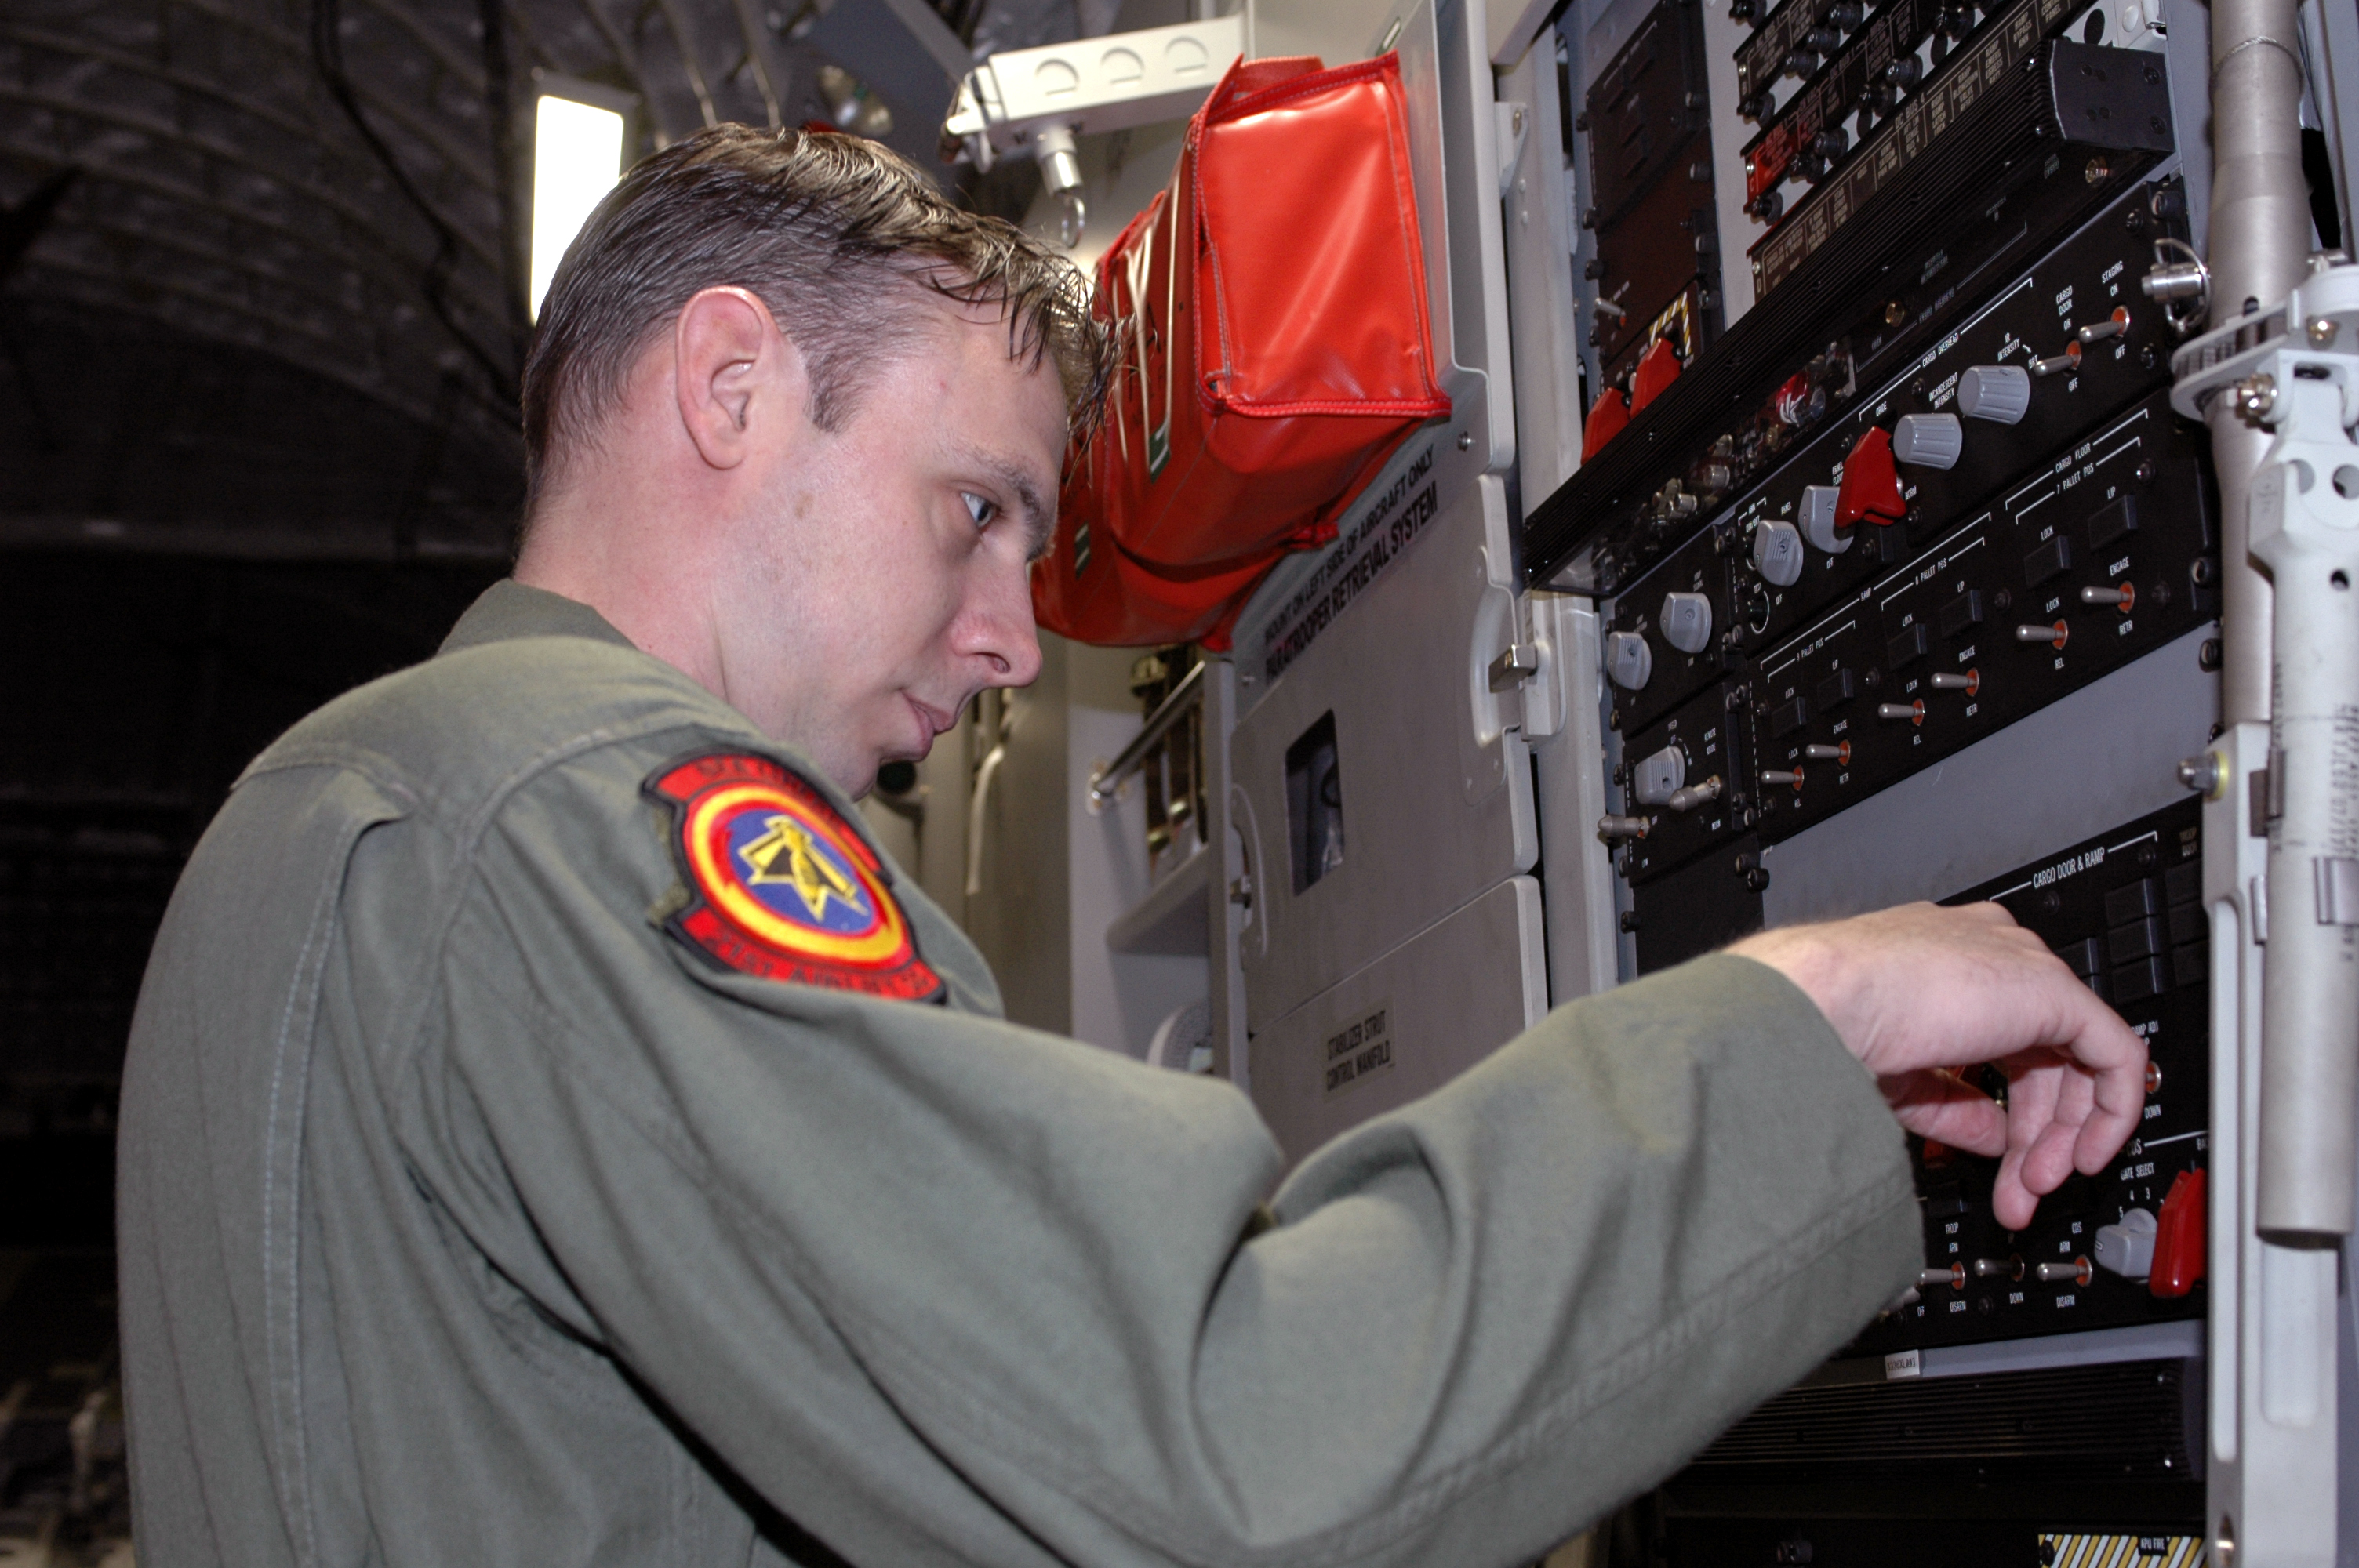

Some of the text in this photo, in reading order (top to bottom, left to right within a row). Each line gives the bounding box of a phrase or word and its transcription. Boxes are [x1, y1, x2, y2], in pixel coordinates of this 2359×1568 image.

[2102, 260, 2124, 285] STAGING
[2055, 285, 2074, 305] CARGO
[2110, 282, 2119, 297] ON
[2058, 298, 2073, 317] DOOR
[2063, 317, 2072, 332] ON
[1997, 337, 2020, 362] INTENSITY
[2115, 343, 2126, 361] OFF
[1928, 372, 1957, 402] INCANDESCENT
[2068, 377, 2078, 394] OFF
[1934, 387, 1954, 410] INTENSITY
[2055, 442, 2091, 474] CARGO FLOOR
[2062, 470, 2081, 491] PALLET
[2082, 463, 2095, 478] POS
[1306, 565, 1327, 602] LEFT
[1347, 530, 1358, 555] OF
[1360, 475, 1406, 542] AIRCRAFT
[1408, 444, 1434, 488] ONLY
[2041, 524, 2054, 542] LOCK
[1332, 534, 1390, 617] RETRIEVAL
[1391, 481, 1438, 555] SYSTEM
[1920, 564, 1936, 582] PALLET
[1937, 557, 1947, 572] POS
[2109, 556, 2130, 577] ENGAGE
[2045, 596, 2060, 614] LOCK
[1902, 612, 1914, 627] LOCK
[1958, 644, 1976, 663] ENGAGE
[2055, 657, 2065, 670] REL
[1785, 686, 1794, 700] LOCK
[1906, 678, 1918, 694] LOCK
[1833, 719, 1848, 735] ENGAGE
[1788, 747, 1799, 760] LOCK
[2033, 846, 2106, 890] CARGO DOOR & RAMP
[1328, 1023, 1362, 1061] STABILIZER
[2143, 1103, 2162, 1120] DOWN
[2120, 1161, 2154, 1181] GATE SELECT
[2140, 1537, 2165, 1551] APU FIRE
